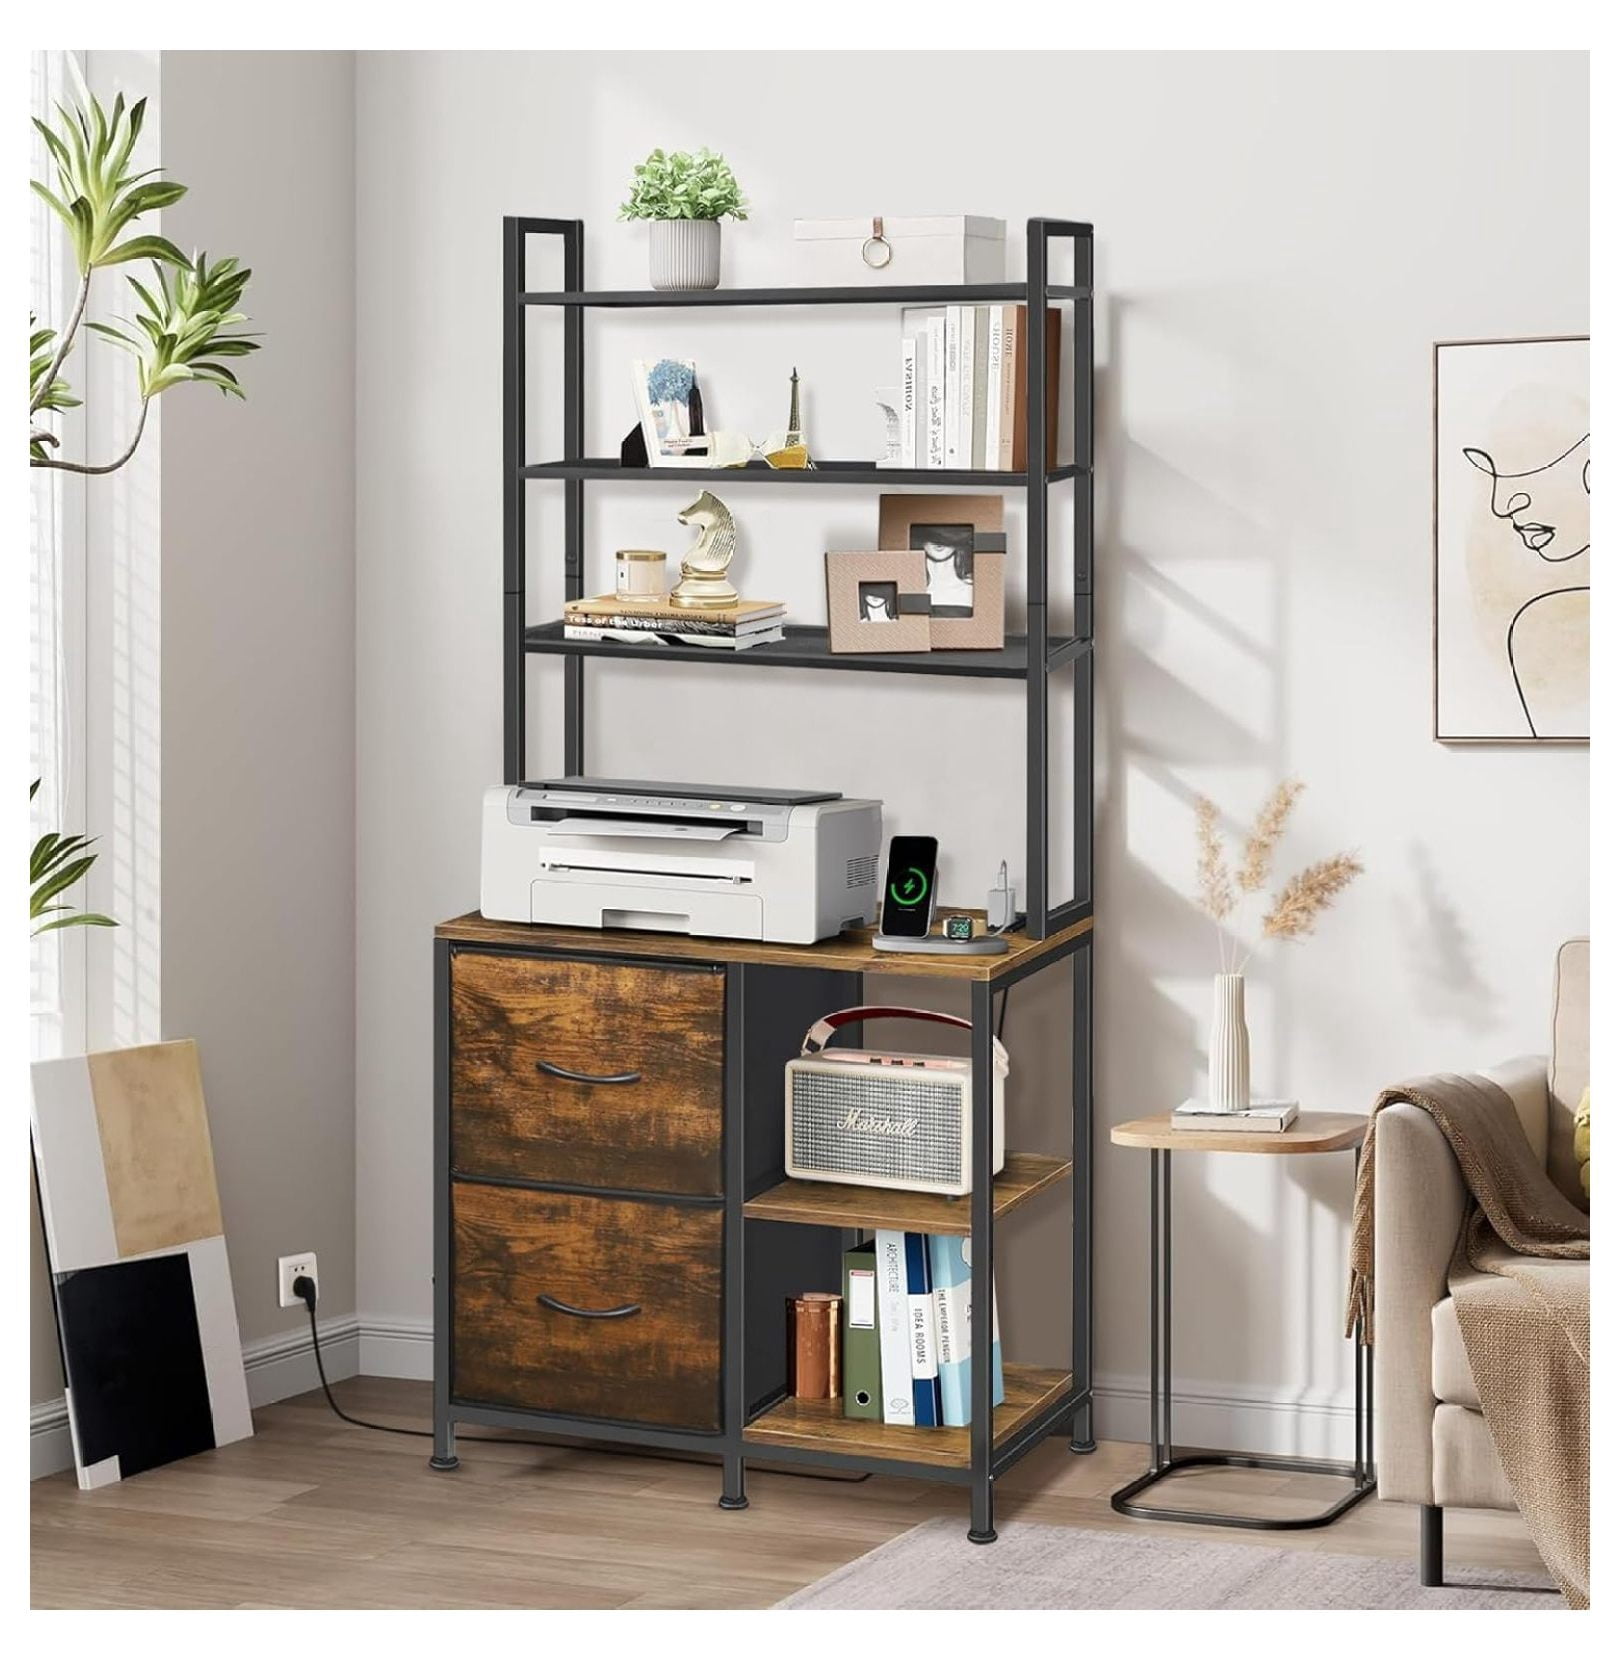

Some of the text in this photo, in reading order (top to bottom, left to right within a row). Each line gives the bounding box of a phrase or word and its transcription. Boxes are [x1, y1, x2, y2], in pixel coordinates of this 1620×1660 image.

[595, 616, 607, 625] of
[836, 1107, 918, 1137] Marshall
[887, 1243, 899, 1293] ARCHITECTURE
[914, 1308, 926, 1364] IDEA ROOMS
[938, 1289, 950, 1363] THE EMPEROR PENGUIN
